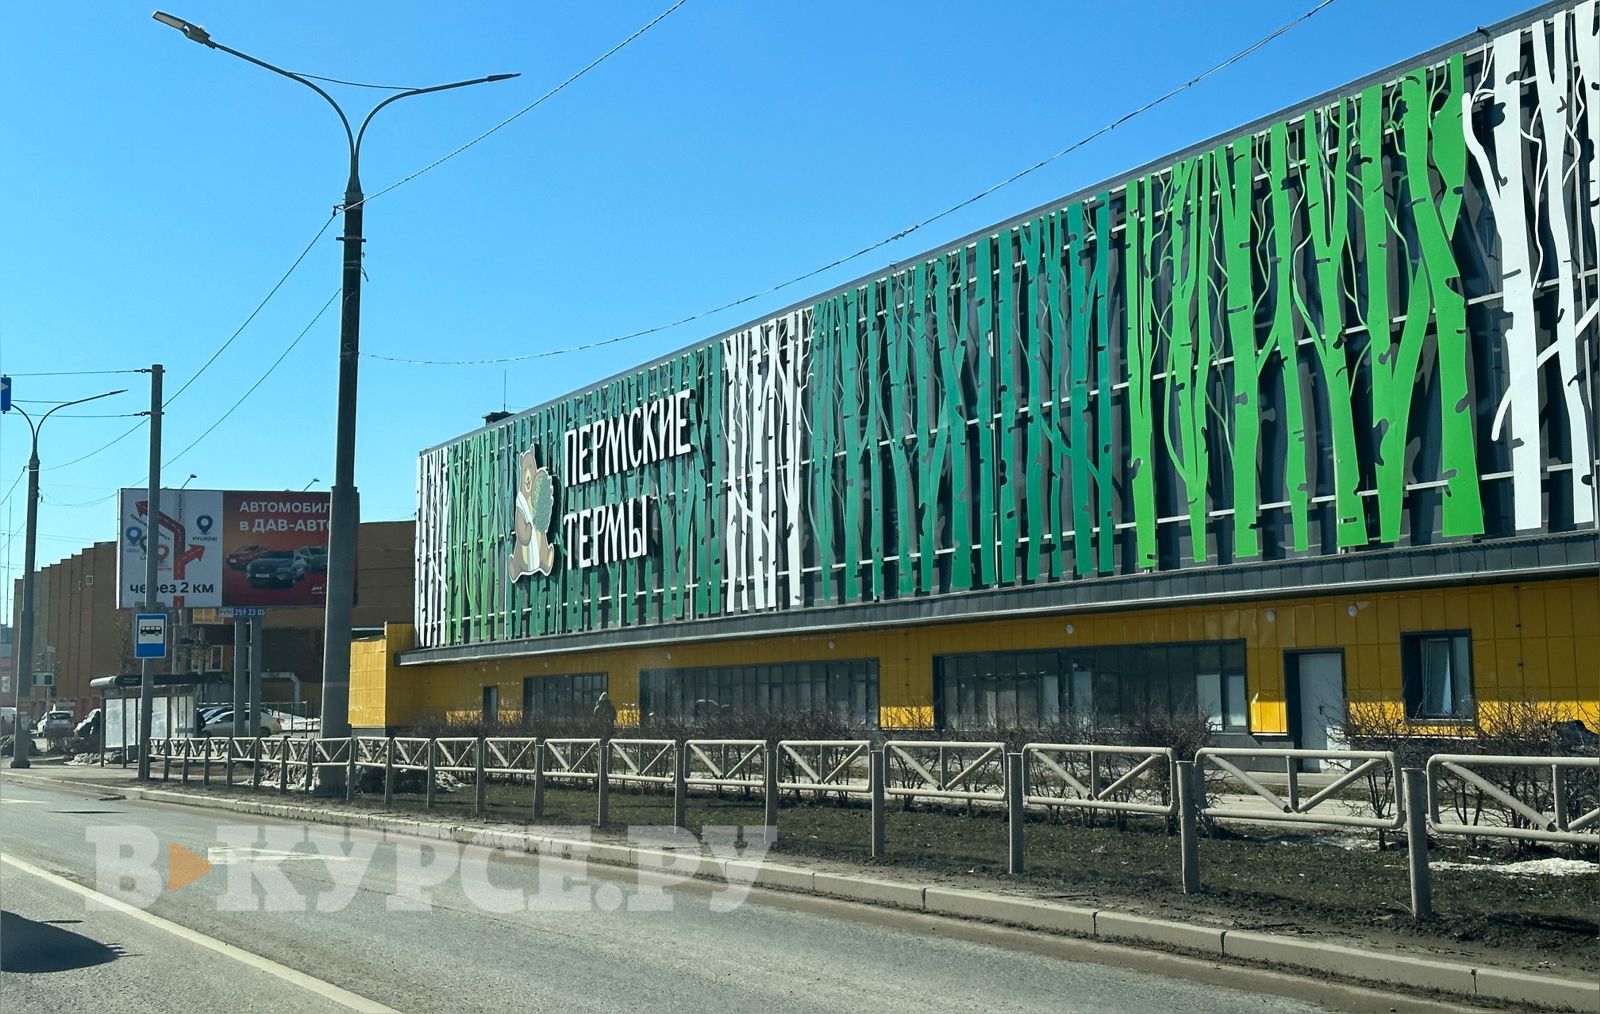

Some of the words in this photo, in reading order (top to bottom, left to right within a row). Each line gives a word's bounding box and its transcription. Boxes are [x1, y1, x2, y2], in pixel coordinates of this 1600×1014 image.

[564, 389, 691, 488] ПЕРМСКИЕ
[239, 520, 249, 531] в
[252, 518, 330, 533] ДАВ-АВТ
[563, 494, 649, 570] ТЕРМЫ
[130, 584, 177, 594] чеез
[180, 581, 189, 593] 2
[192, 584, 214, 593] км
[248, 608, 256, 616] 23
